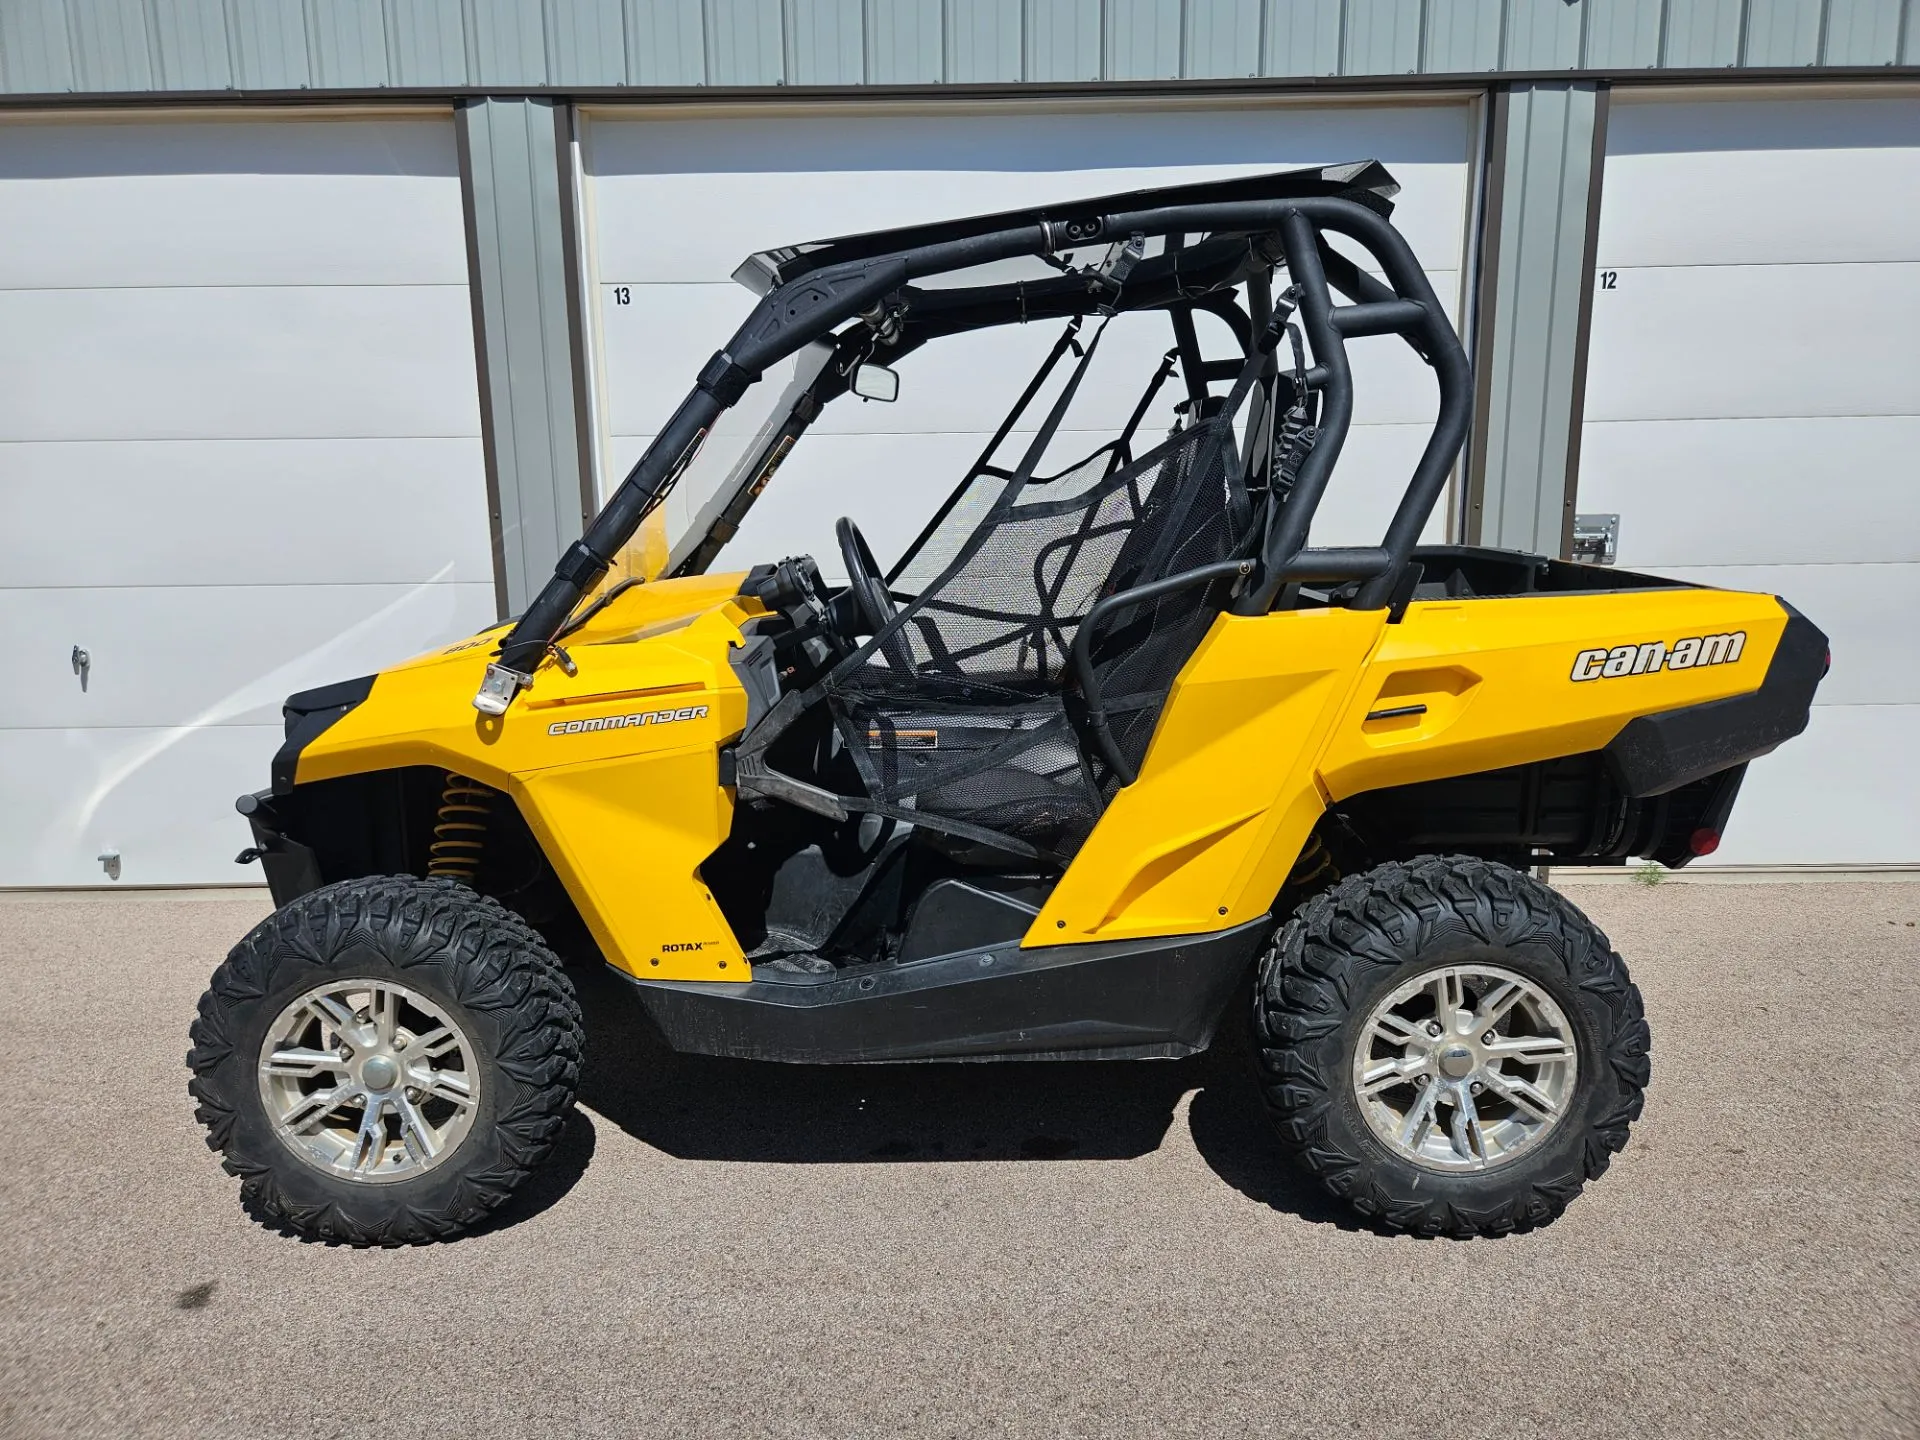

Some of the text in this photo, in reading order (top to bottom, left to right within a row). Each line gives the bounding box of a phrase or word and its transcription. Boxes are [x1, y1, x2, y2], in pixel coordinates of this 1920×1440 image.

[1600, 271, 1618, 290] 12
[613, 287, 631, 305] 13
[548, 705, 709, 736] COMMANDER
[661, 942, 703, 953] ROTAX
